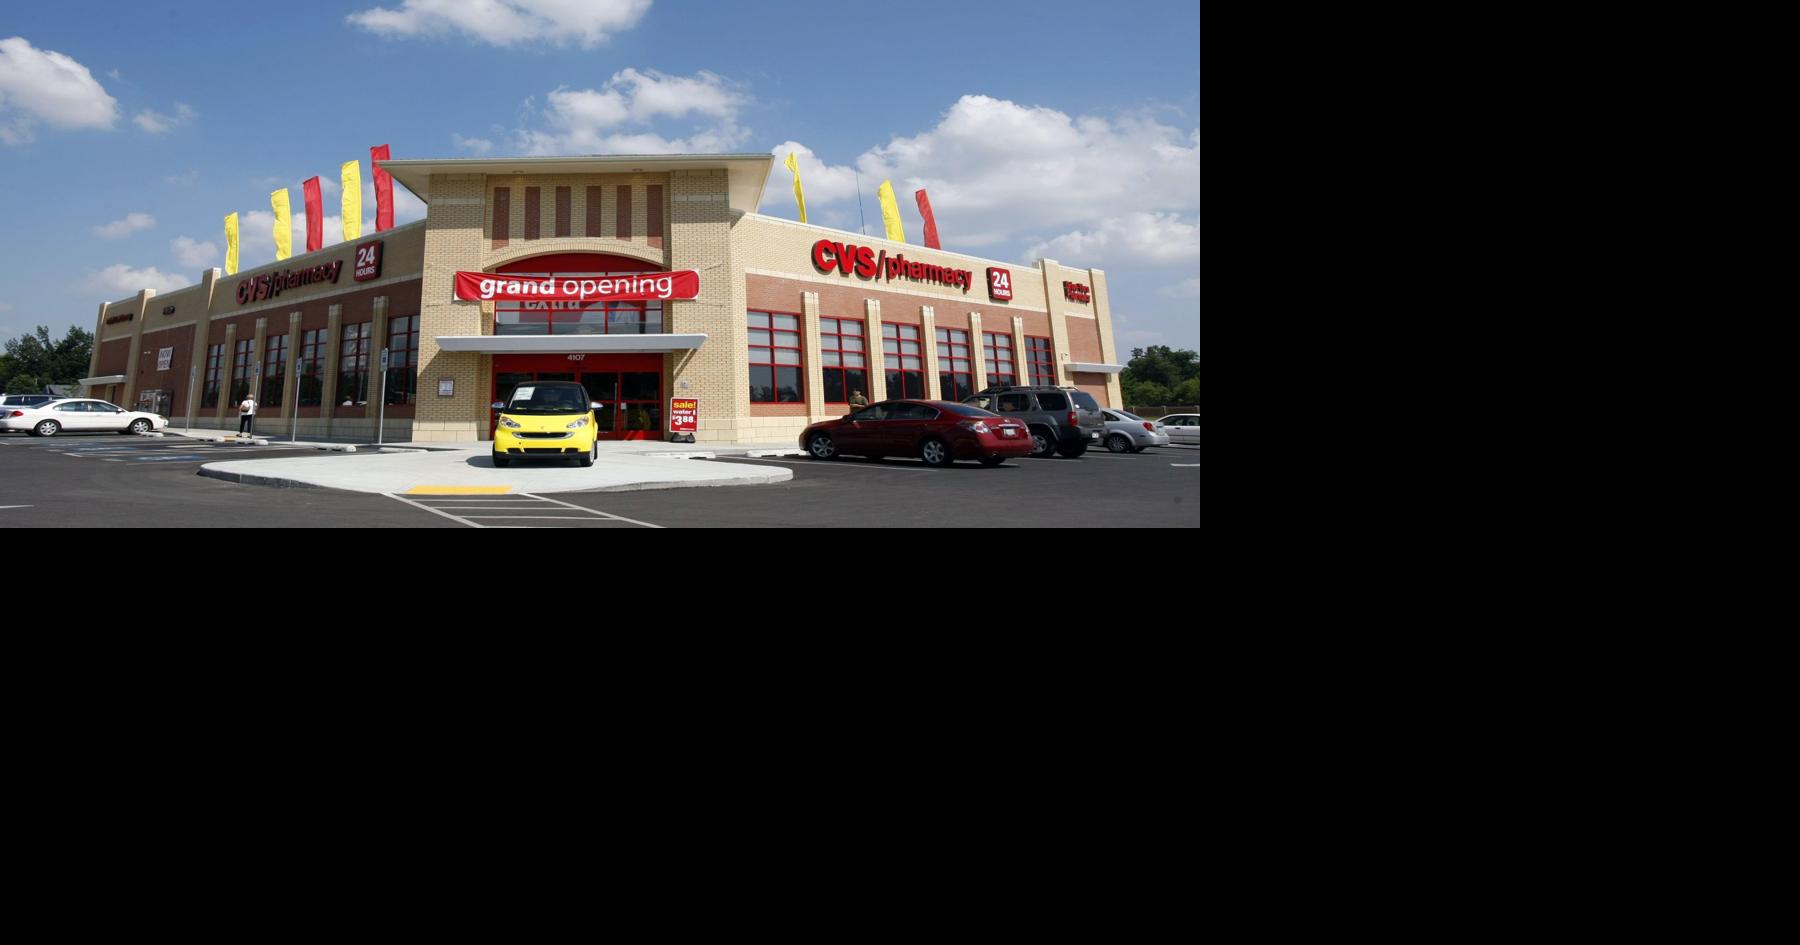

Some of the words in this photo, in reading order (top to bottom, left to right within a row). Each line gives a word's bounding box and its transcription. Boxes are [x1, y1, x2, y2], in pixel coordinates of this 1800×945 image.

[357, 246, 375, 267] 24
[812, 239, 972, 293] CVS/pharmacy
[236, 260, 343, 304] CVS/pharmacy
[356, 266, 375, 277] HOURS
[993, 271, 1009, 288] 24
[480, 276, 555, 298] grand
[563, 275, 673, 299] opening
[993, 287, 1011, 297] HOURS
